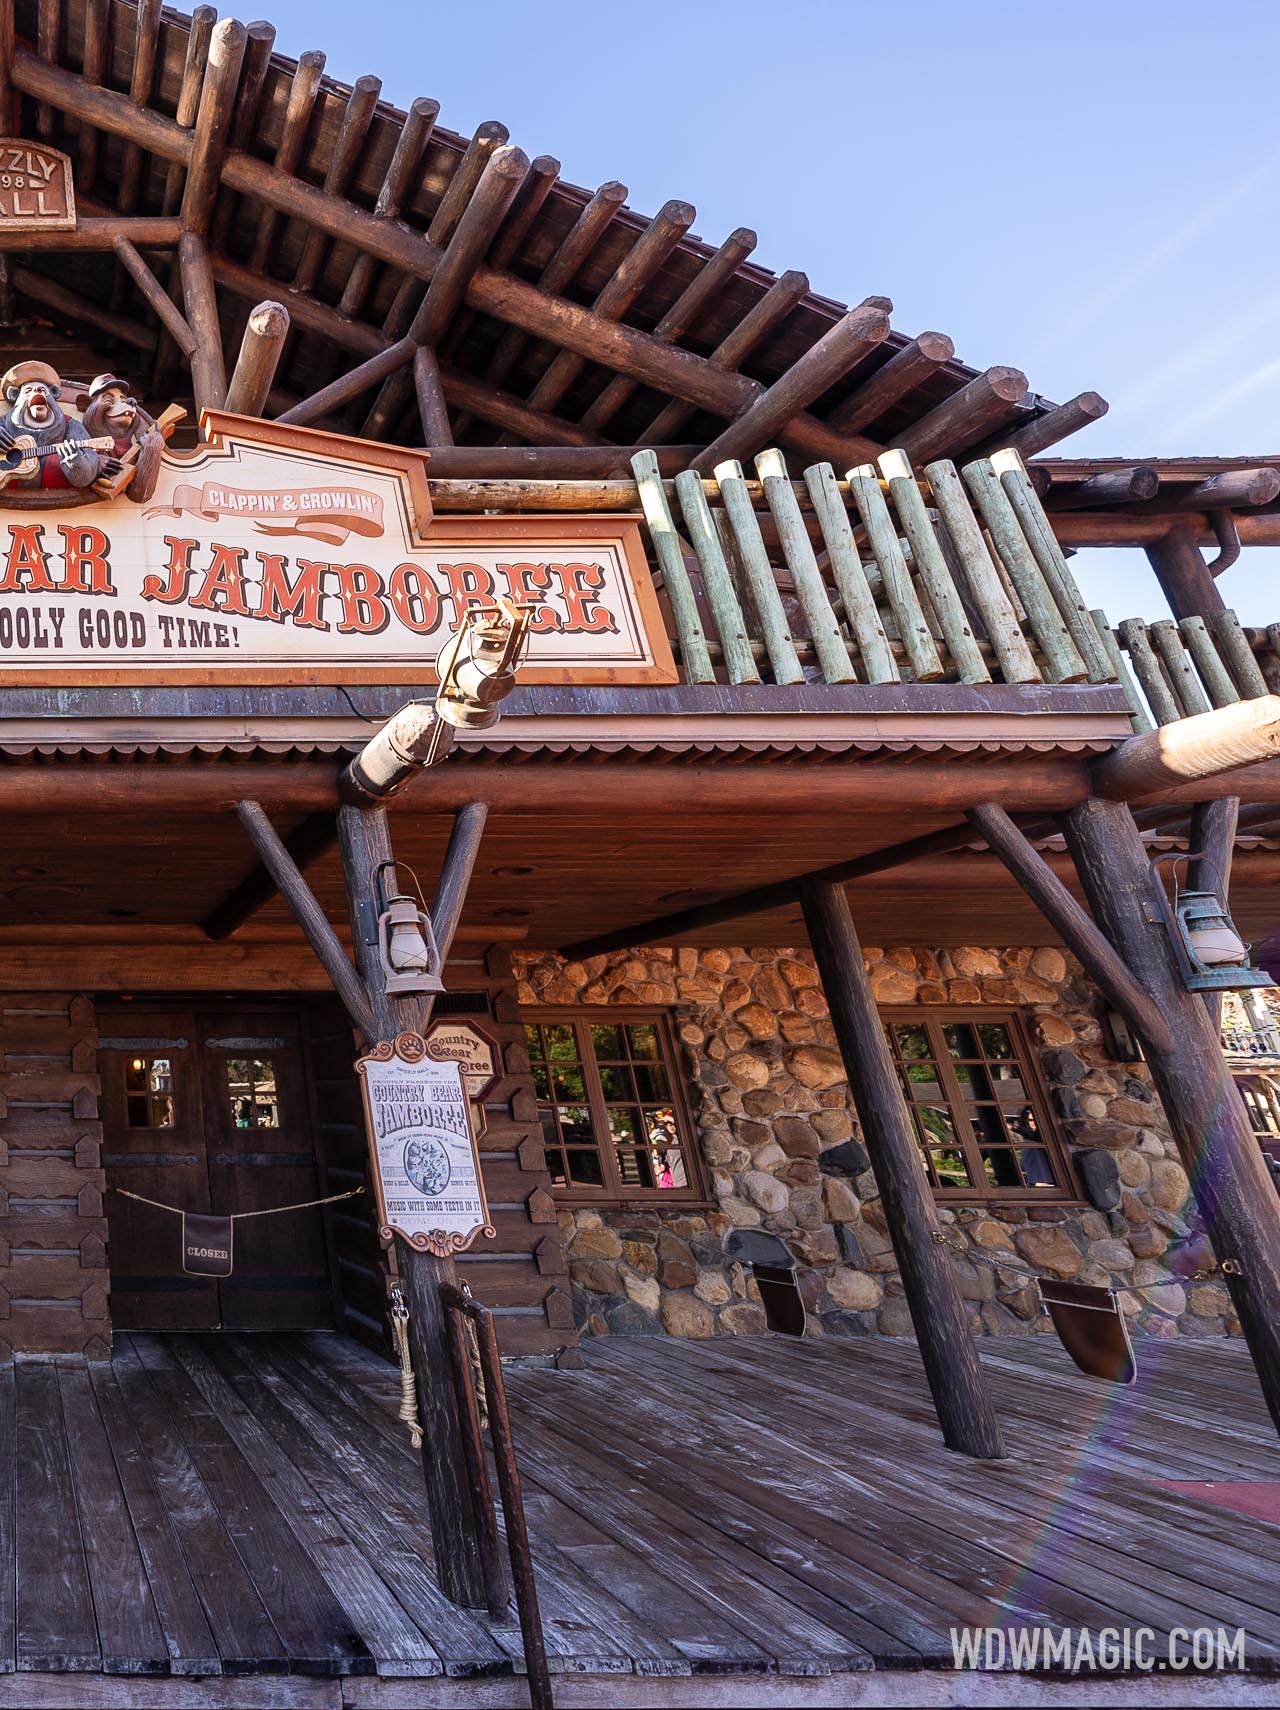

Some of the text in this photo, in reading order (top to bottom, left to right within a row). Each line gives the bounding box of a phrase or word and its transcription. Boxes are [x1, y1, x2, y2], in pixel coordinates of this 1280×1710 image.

[207, 489, 378, 513] CLAPPIN' & GROWLIN'
[140, 535, 621, 636] JAMBOREE
[79, 608, 146, 649] GOOD
[158, 616, 240, 649] TIME!
[450, 1048, 472, 1059] ear
[372, 1085, 462, 1102] COUNTRY BEAR
[376, 1104, 469, 1139] JAMBOREE
[387, 1201, 480, 1211] MUSIC WITH SOME TEETH IN IT
[187, 1247, 228, 1259] CLOSED
